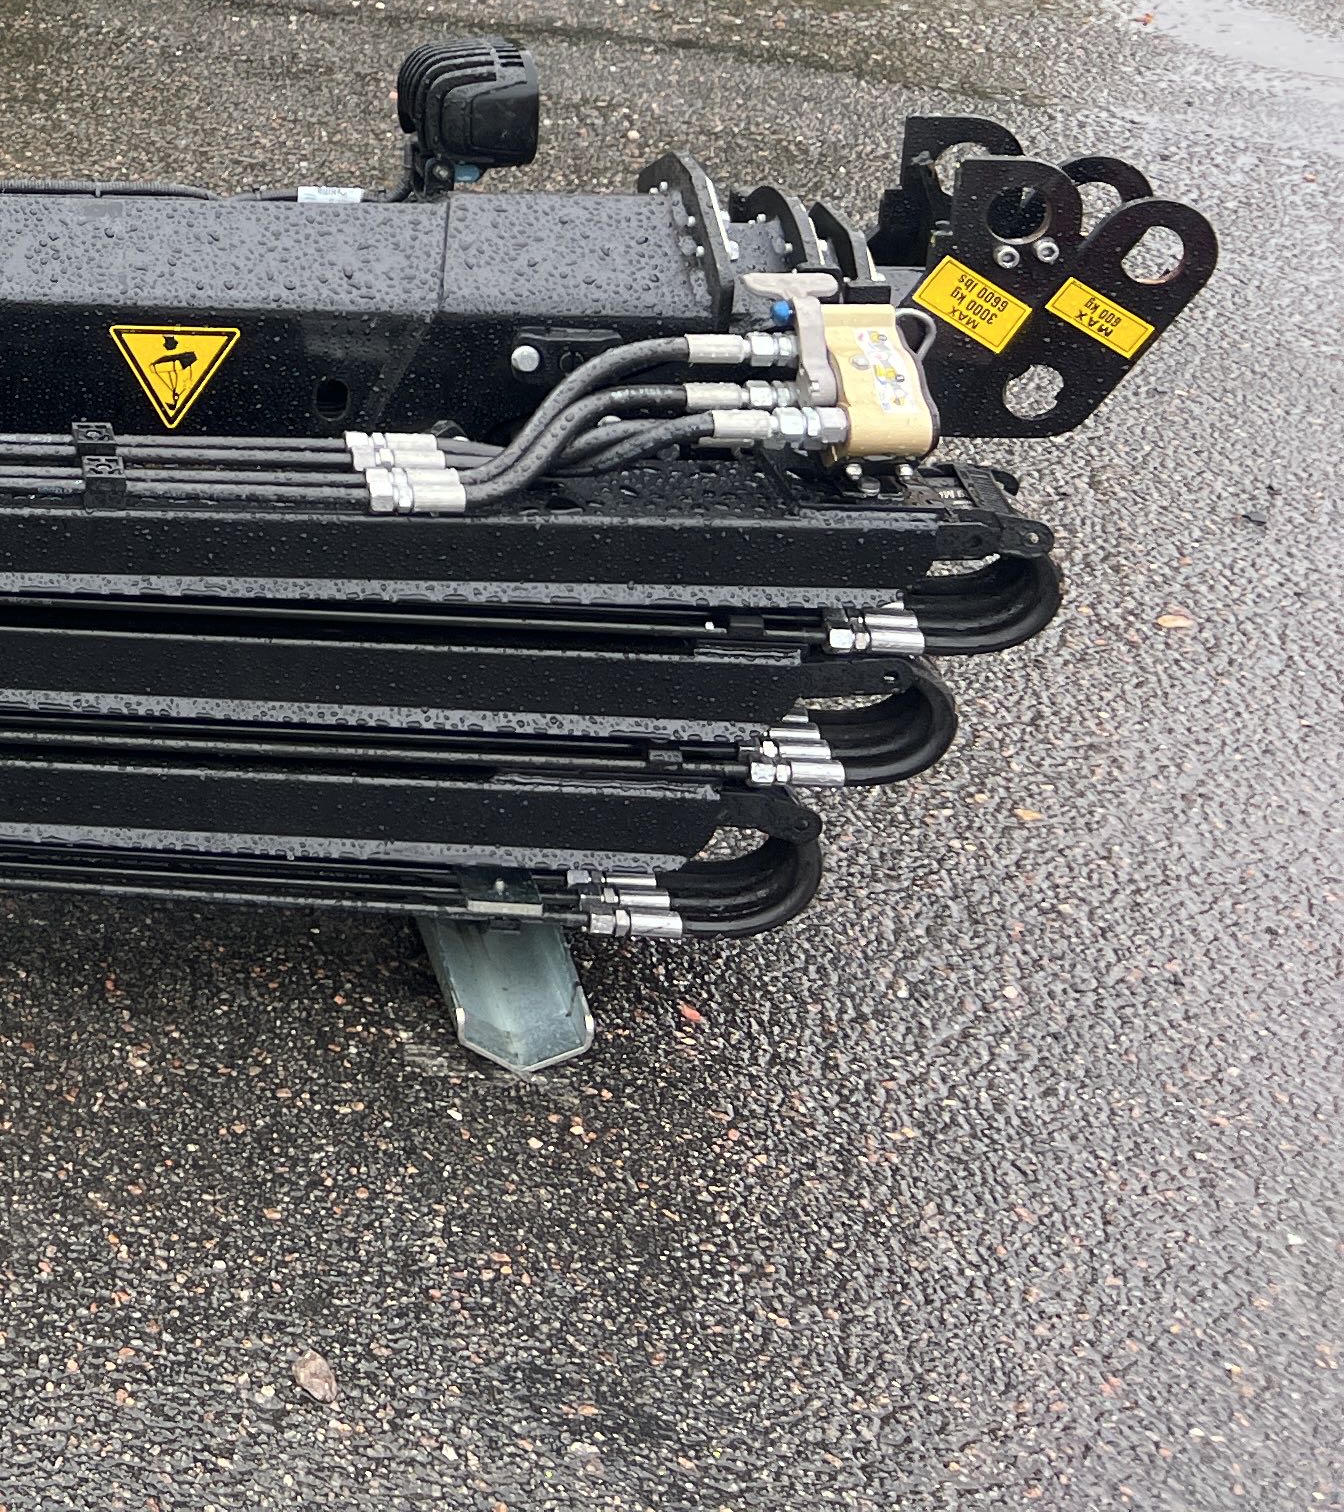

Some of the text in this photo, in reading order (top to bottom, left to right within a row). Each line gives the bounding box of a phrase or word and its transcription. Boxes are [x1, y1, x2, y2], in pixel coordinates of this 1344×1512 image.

[950, 287, 998, 326] 3000 kg
[958, 273, 1010, 313] 6600 lbs
[1083, 296, 1102, 315] kg
[948, 305, 980, 330] MAX
[1075, 310, 1115, 338] MAX
